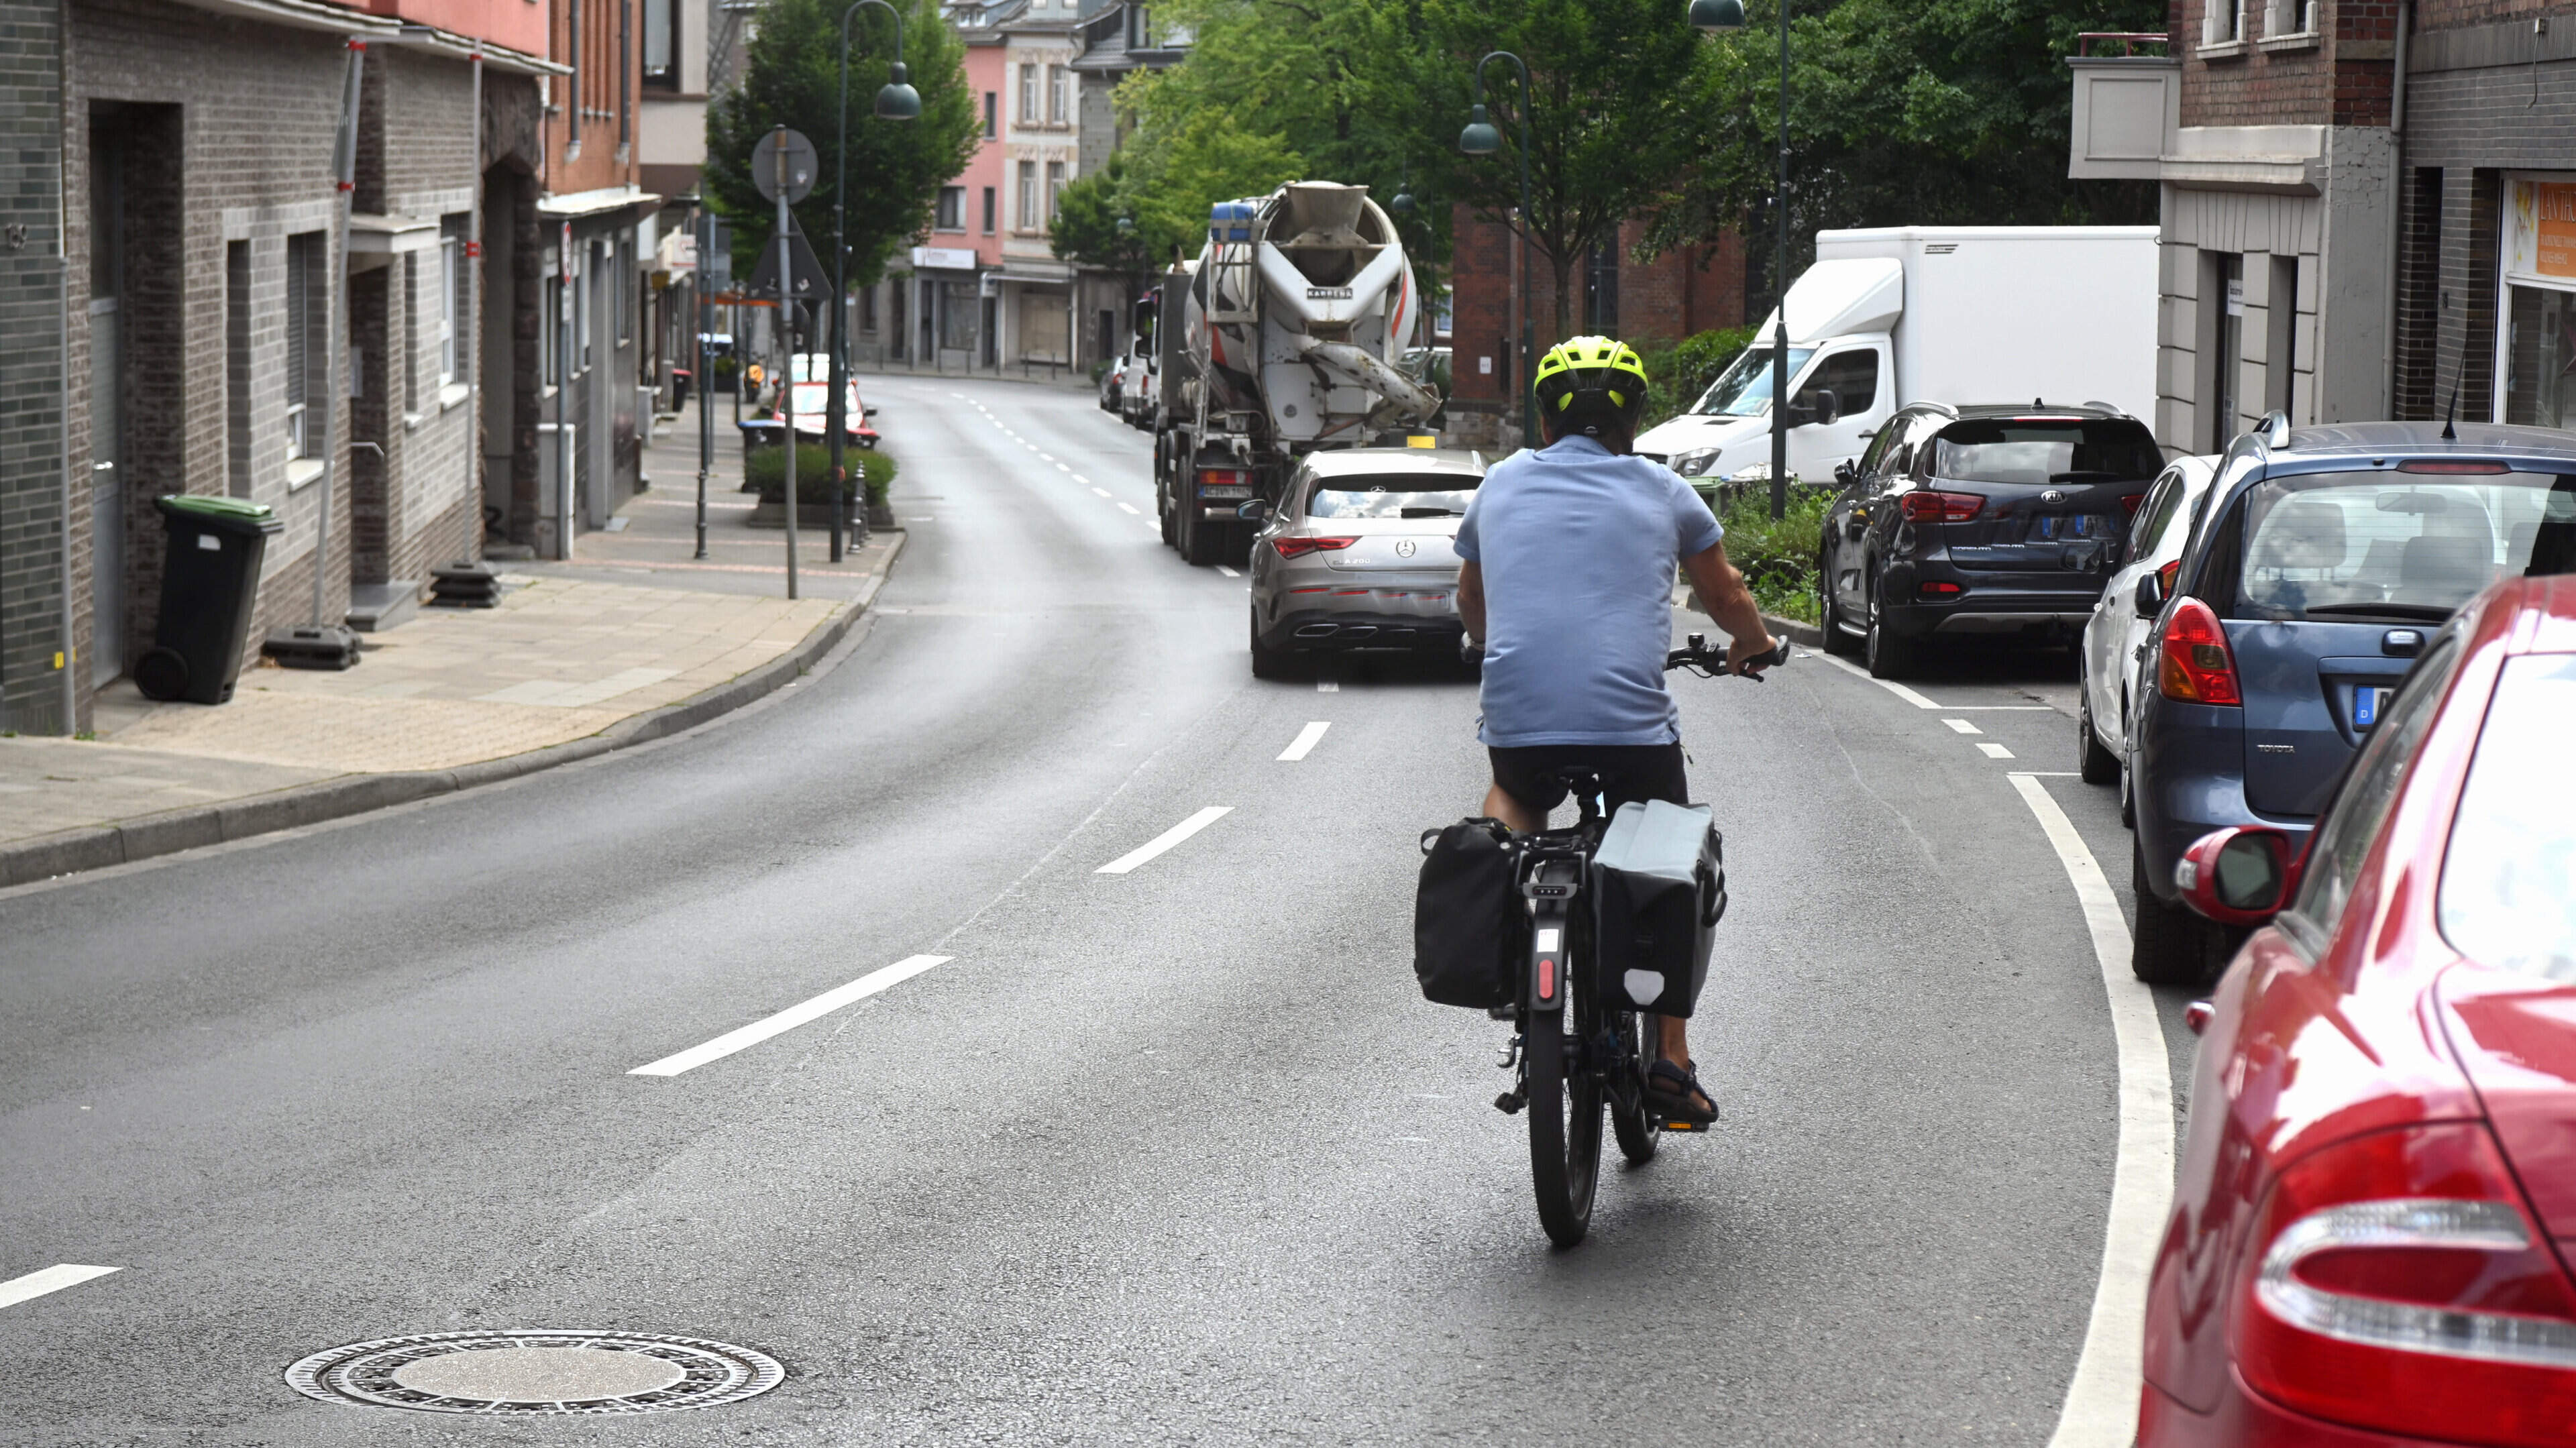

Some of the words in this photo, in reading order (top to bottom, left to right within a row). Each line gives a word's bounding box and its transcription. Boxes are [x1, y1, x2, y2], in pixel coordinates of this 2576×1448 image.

[2045, 493, 2063, 501] KIA
[2361, 710, 2368, 718] D
[2257, 744, 2296, 753] TOYOTA
